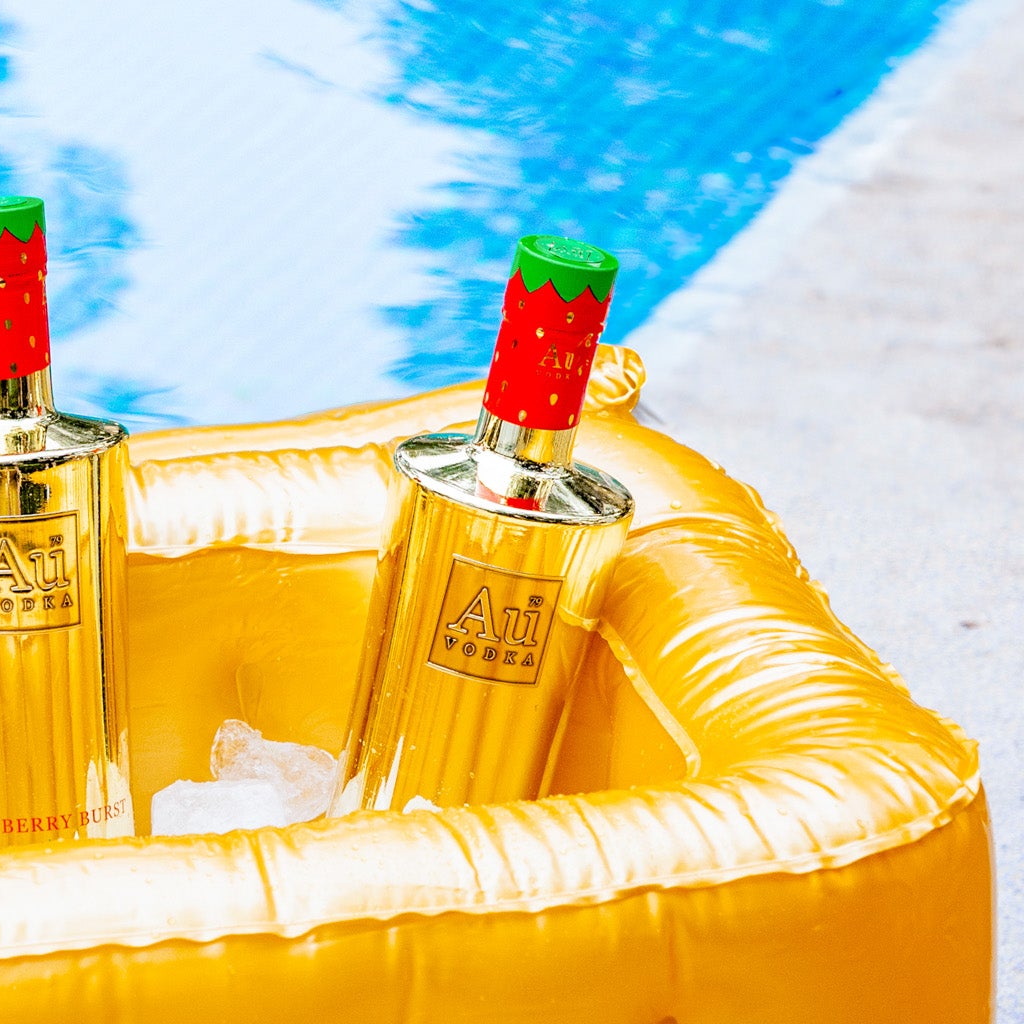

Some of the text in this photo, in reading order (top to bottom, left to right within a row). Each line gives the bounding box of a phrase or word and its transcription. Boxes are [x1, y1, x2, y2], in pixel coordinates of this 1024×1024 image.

[537, 343, 575, 371] Au
[48, 534, 64, 547] 79
[528, 596, 544, 608] 79
[446, 586, 541, 648] Au
[444, 635, 535, 667] VODKA
[79, 798, 127, 828] BURST
